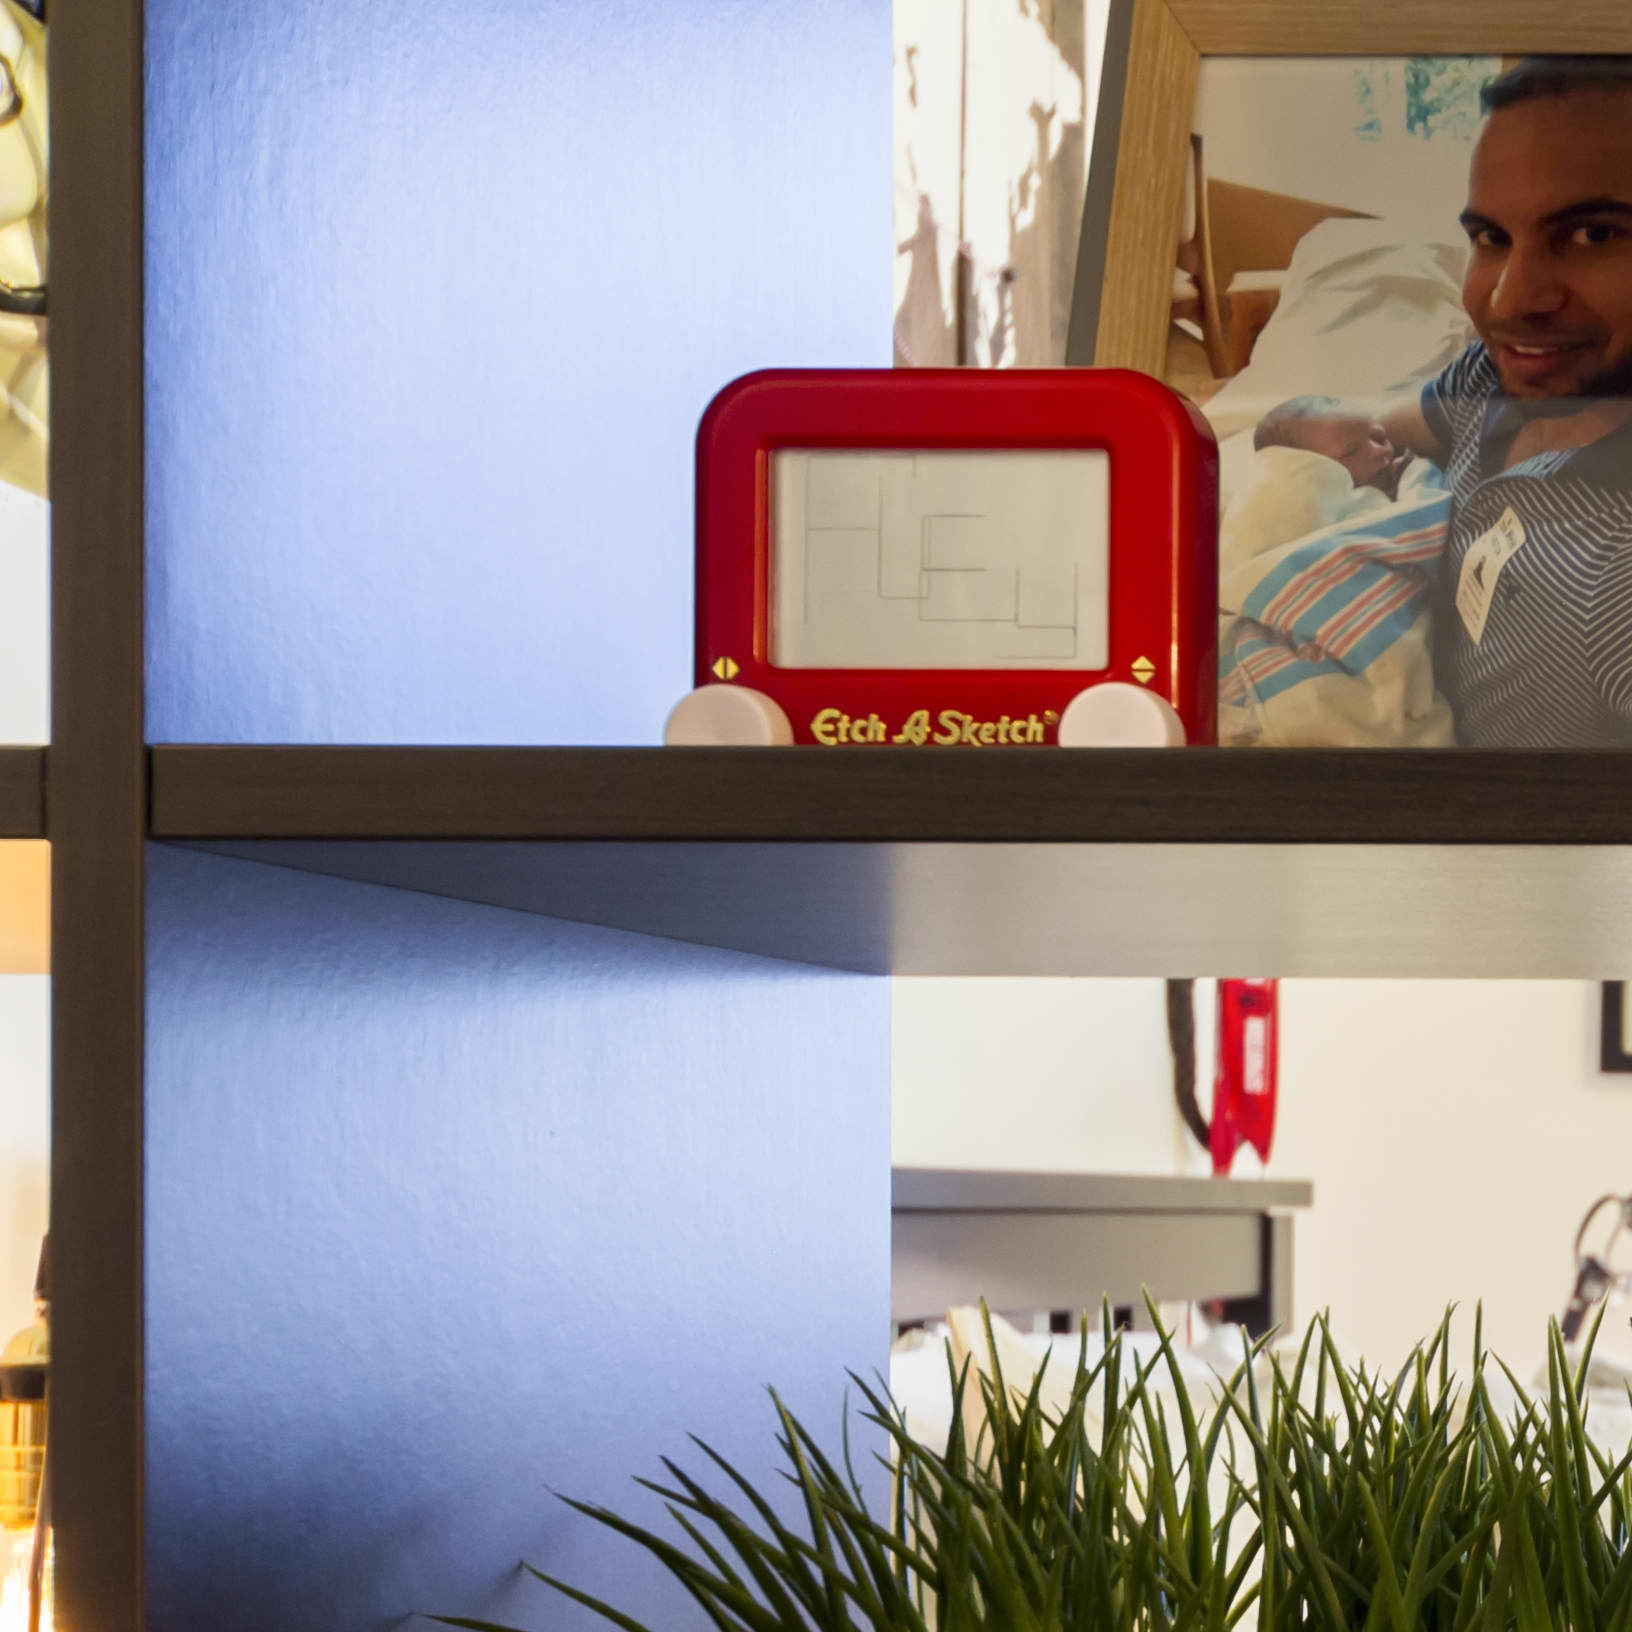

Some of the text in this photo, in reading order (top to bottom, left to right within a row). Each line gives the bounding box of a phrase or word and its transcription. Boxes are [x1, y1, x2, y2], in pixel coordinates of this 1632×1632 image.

[810, 708, 1045, 747] Etch A Sketch
